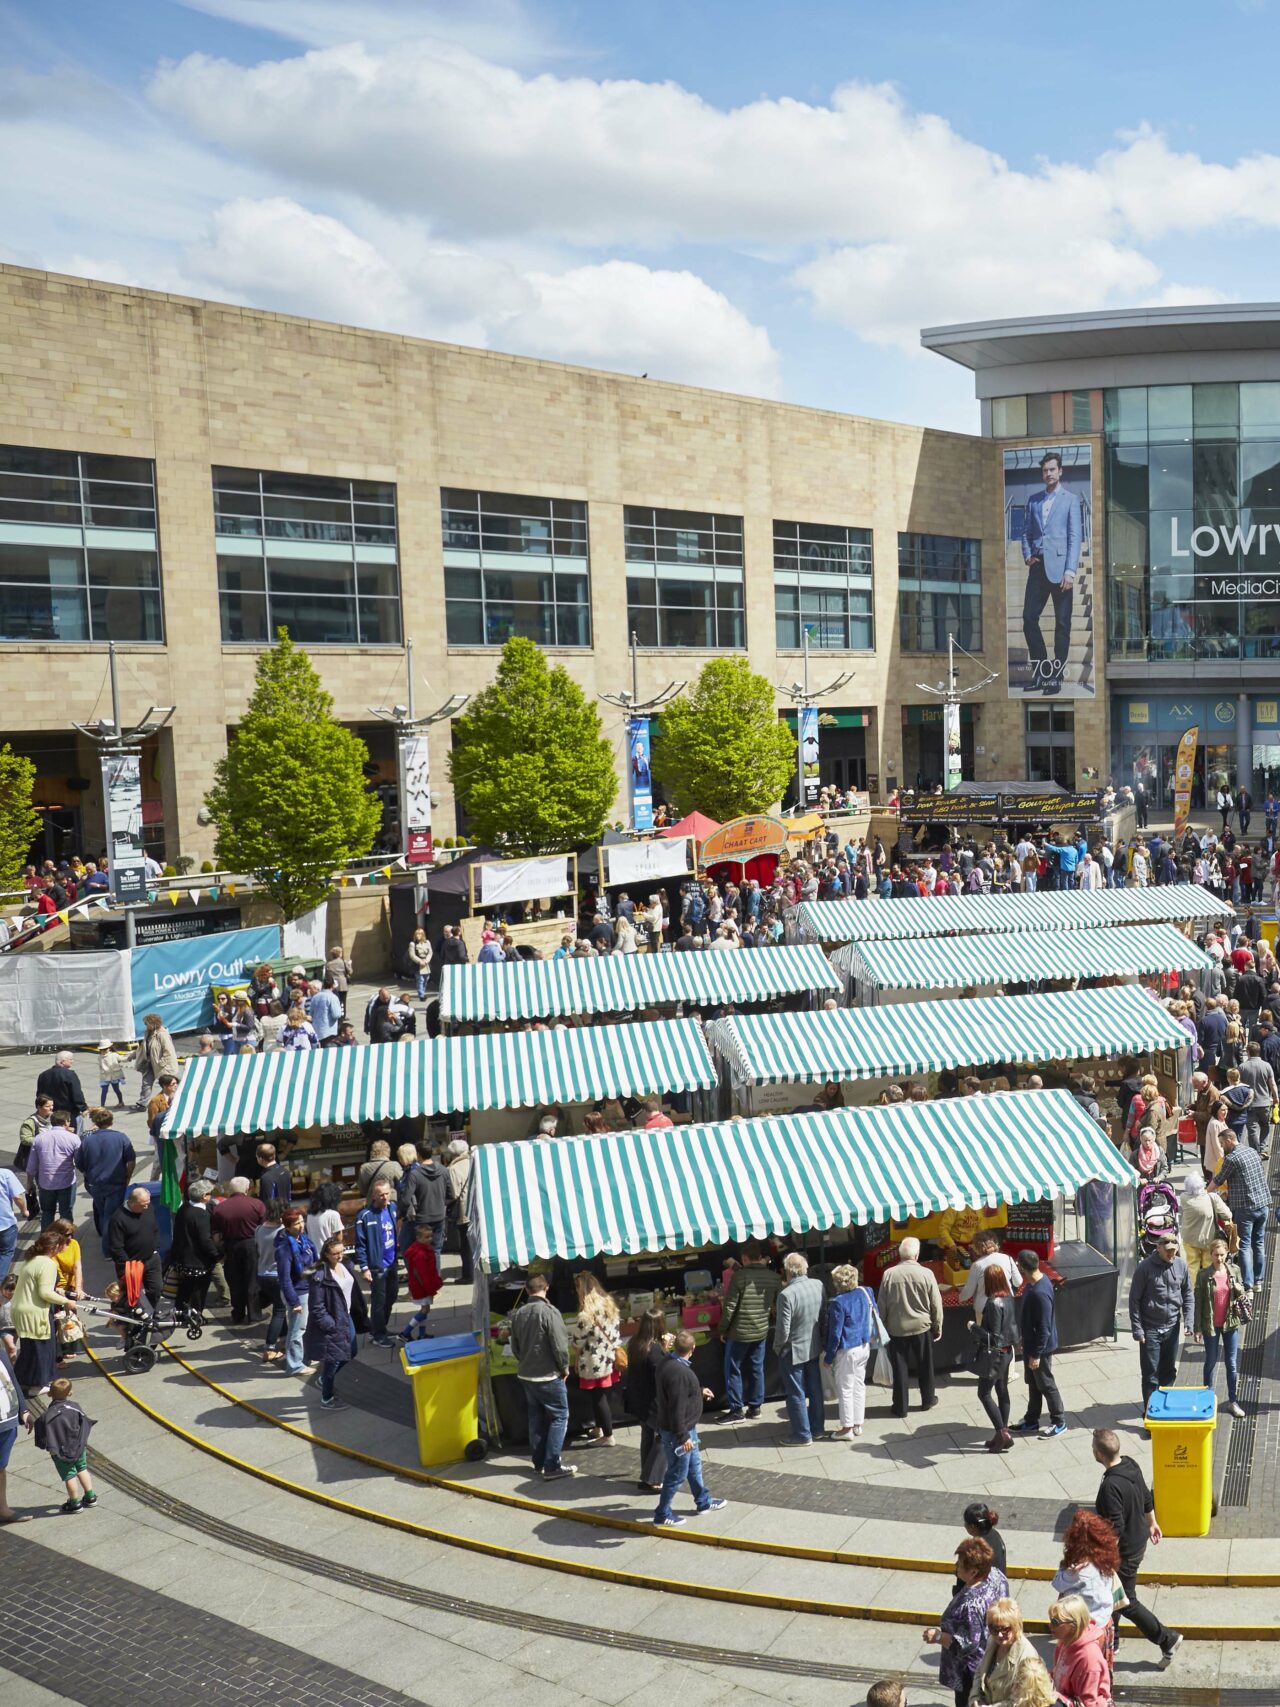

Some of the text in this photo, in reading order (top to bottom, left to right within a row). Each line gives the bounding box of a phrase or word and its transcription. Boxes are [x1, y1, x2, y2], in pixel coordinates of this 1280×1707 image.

[1028, 659, 1070, 678] 70%
[1169, 704, 1194, 716] AX
[1260, 704, 1274, 715] GAP
[1041, 802, 1075, 812] Burger
[724, 836, 767, 849] CHAAT CART
[154, 969, 206, 991] Lowry
